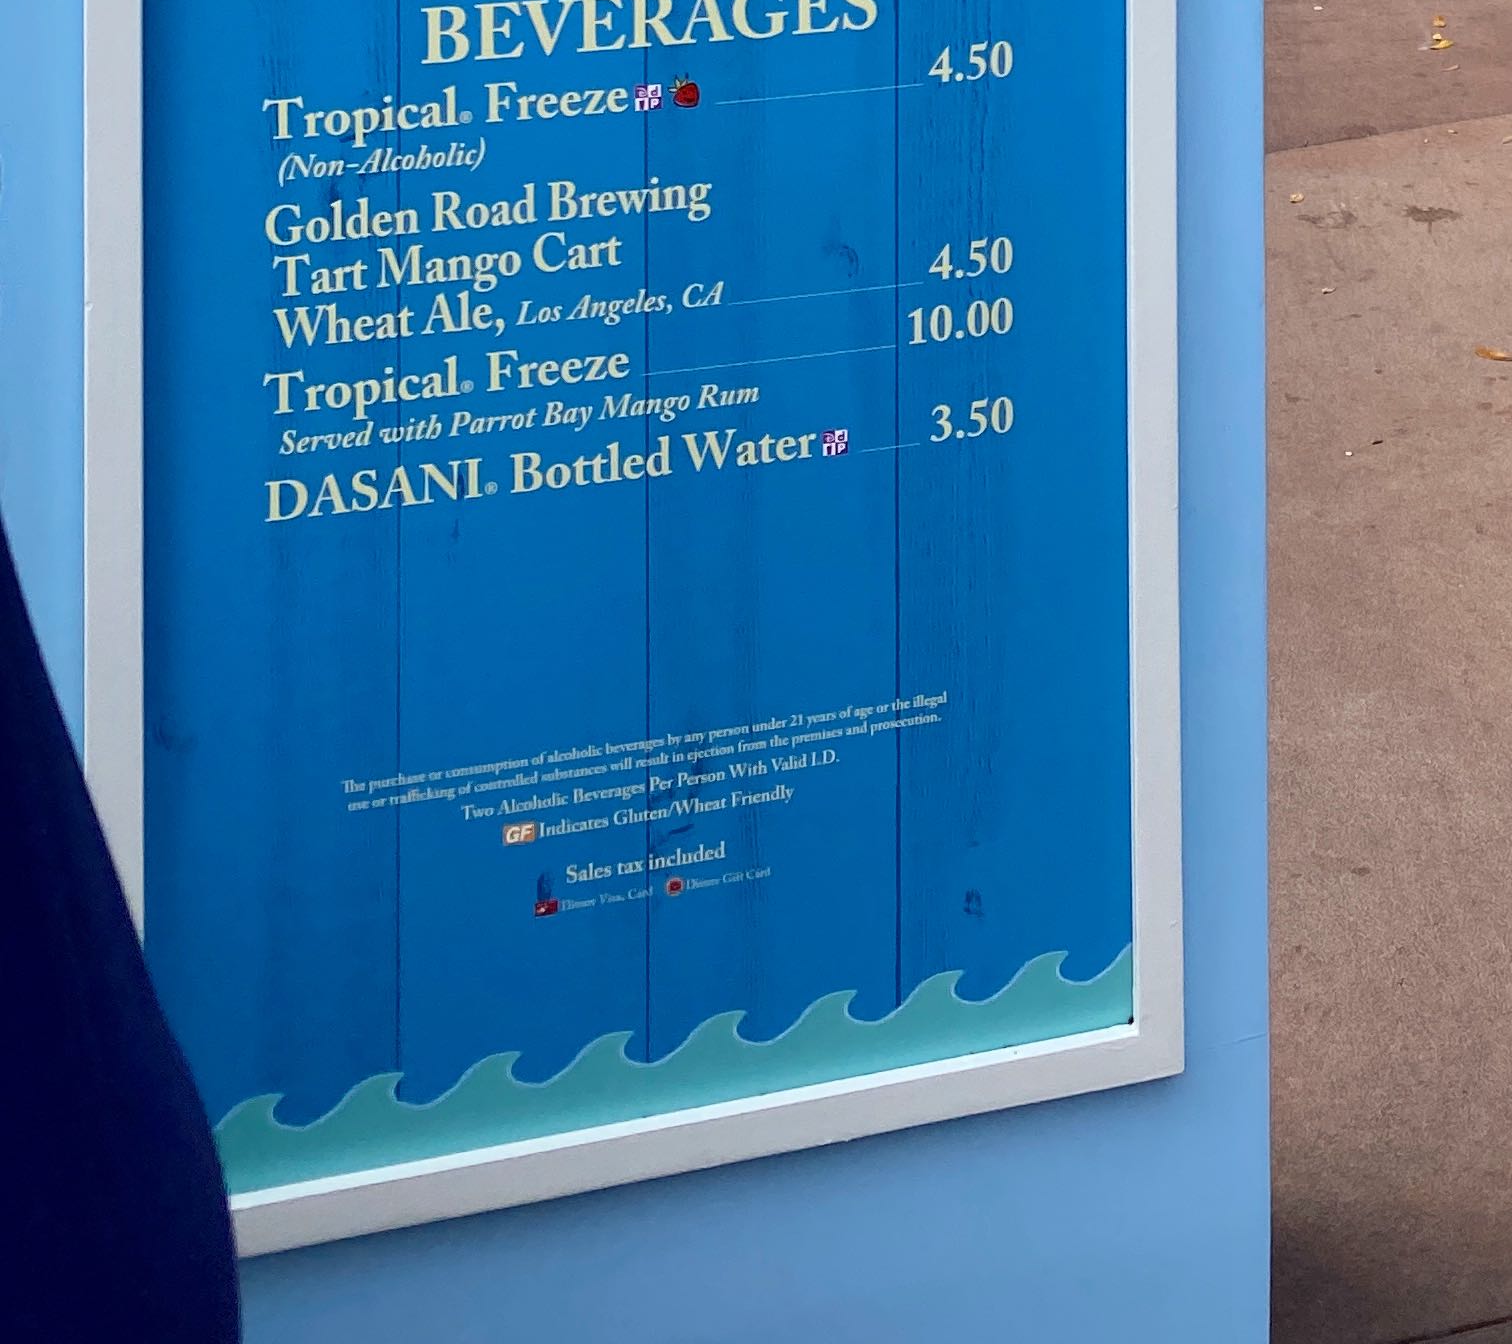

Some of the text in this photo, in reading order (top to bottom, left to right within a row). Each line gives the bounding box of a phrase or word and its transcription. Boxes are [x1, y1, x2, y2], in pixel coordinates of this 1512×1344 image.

[484, 82, 628, 122] Freeze
[928, 41, 1013, 82] 4.50
[279, 137, 485, 187] (Non-Alcoholic)
[265, 178, 713, 245] Golden Road Brewing
[273, 234, 622, 296] Tart Mango Cart
[273, 237, 1013, 348] Wheat Ale, Los Angeles, CA 4.50
[486, 350, 629, 391] Freeze
[908, 298, 1013, 344] 10.00
[279, 384, 759, 454] Served with Parrot Bay Mango Rum
[510, 435, 672, 493] Bottled
[681, 429, 816, 471] Water
[930, 397, 1013, 442] 3.50
[461, 804, 495, 821] Two
[497, 792, 568, 815] Alcoholic
[573, 783, 646, 804] Beverages
[649, 776, 674, 794] Per
[675, 771, 726, 787] Person
[728, 760, 768, 778] With
[771, 753, 808, 773] Valid
[505, 787, 794, 844] GF Indicates Gluten/Wheat Friendly
[566, 842, 726, 883] Sales tax included
